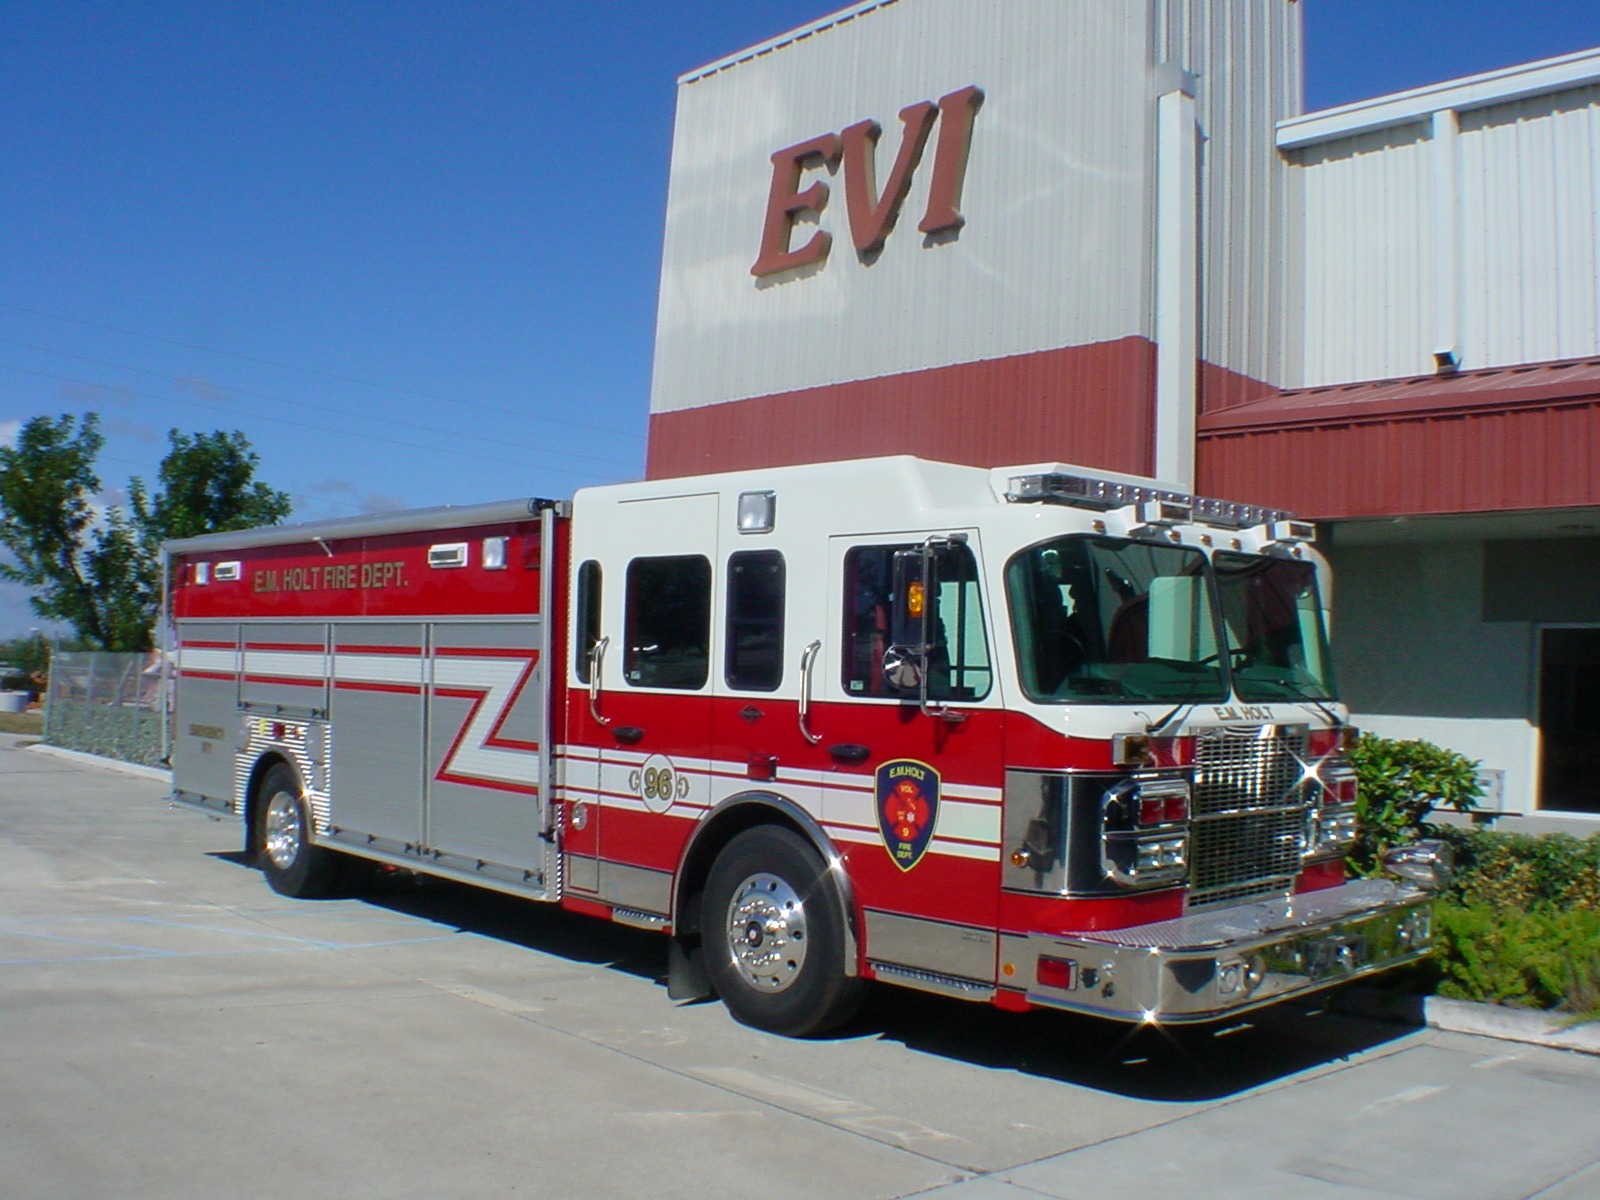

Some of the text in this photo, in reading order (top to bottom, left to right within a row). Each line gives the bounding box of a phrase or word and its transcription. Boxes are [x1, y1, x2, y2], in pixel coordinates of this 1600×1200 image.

[750, 84, 985, 280] EVI
[283, 567, 321, 591] HOLT
[323, 565, 357, 589] FIRE
[361, 561, 408, 588] DEPT.
[1239, 706, 1275, 720] HOLT
[644, 767, 673, 801] 96
[902, 827, 909, 836] 9
